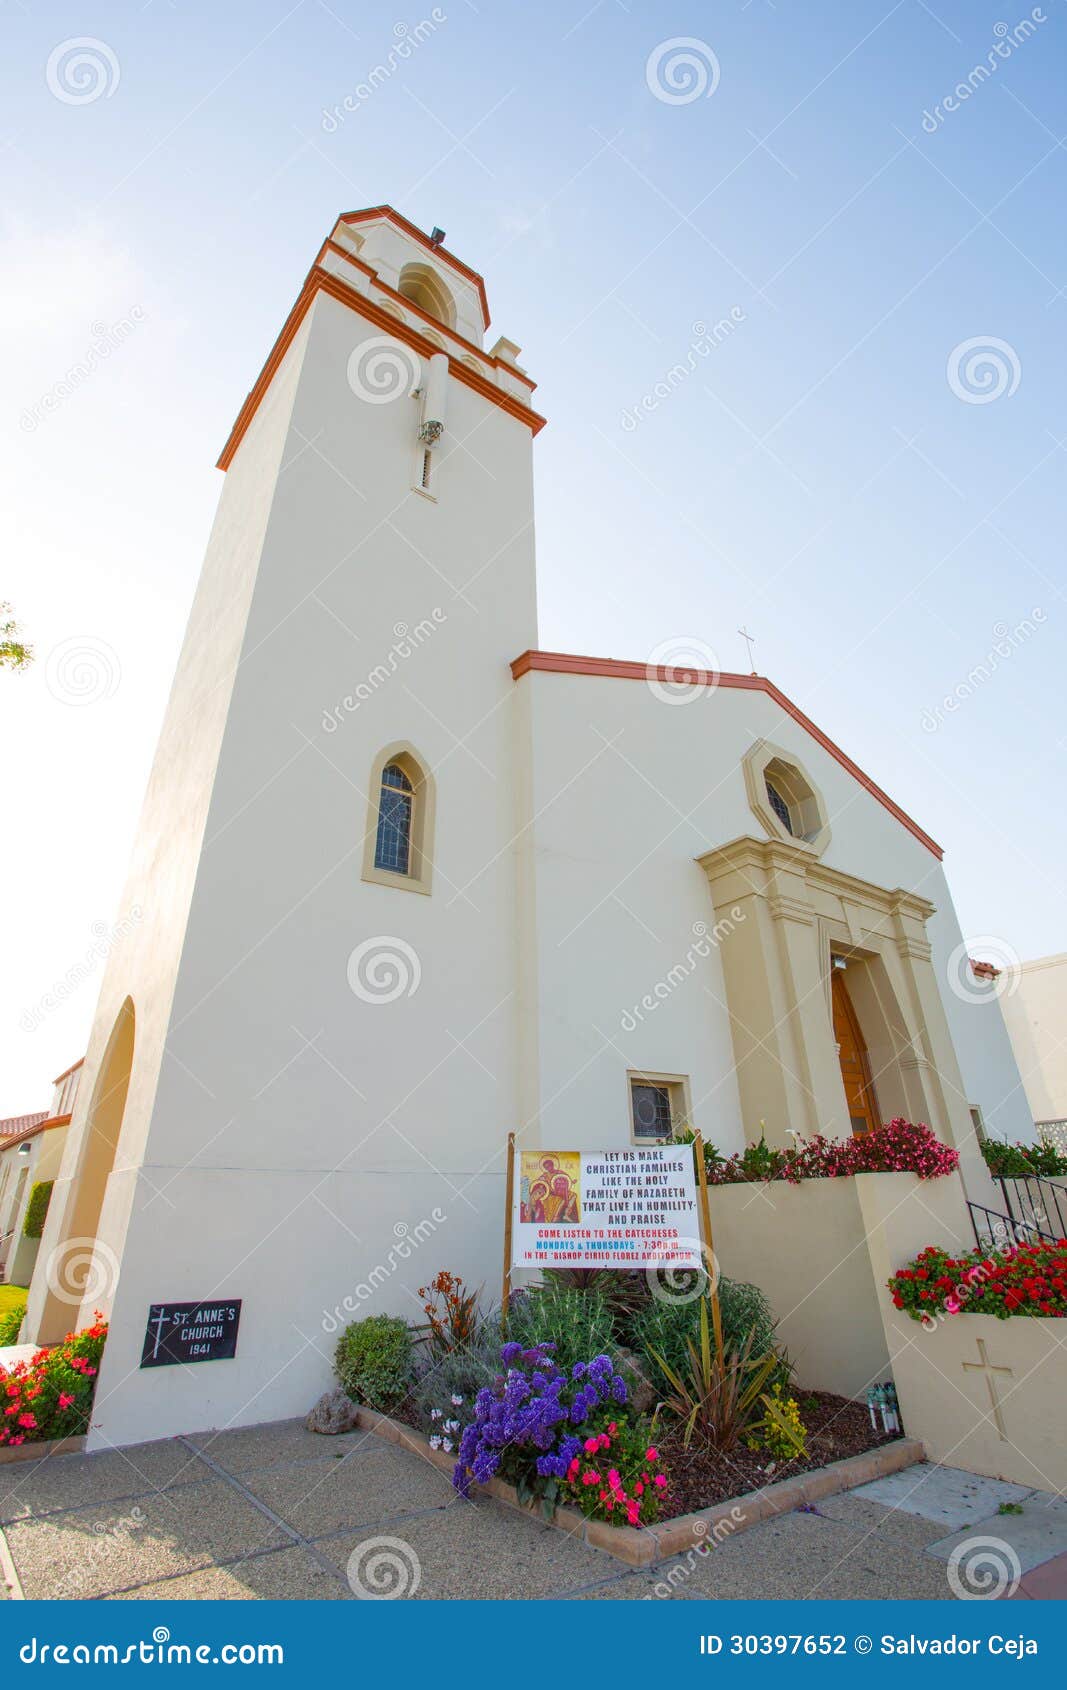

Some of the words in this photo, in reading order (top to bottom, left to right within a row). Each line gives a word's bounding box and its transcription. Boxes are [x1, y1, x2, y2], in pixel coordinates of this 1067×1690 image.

[605, 1152, 619, 1161] LET
[623, 1152, 635, 1160] US
[638, 1151, 664, 1160] MAKE
[586, 1164, 637, 1174] CHRISTIAN
[640, 1162, 684, 1173] FAMILIES
[602, 1177, 622, 1186] LIKE
[625, 1176, 642, 1185] THE
[645, 1175, 668, 1185] HOLY
[586, 1189, 618, 1199] FAMILY
[622, 1189, 634, 1199] OF
[637, 1187, 685, 1198] NAZARETH
[583, 1202, 606, 1212] THAT
[609, 1202, 630, 1211] LIVE
[633, 1201, 643, 1211] IN
[608, 1215, 627, 1225] AND
[631, 1214, 666, 1225] PRAISE
[538, 1229, 561, 1239] COME
[563, 1229, 591, 1239] LISTEN
[594, 1229, 604, 1239] TO
[607, 1229, 622, 1239] THE
[625, 1228, 678, 1238] CATECHESES
[536, 1241, 574, 1250] MONDAYS
[586, 1240, 635, 1250] THURSDAYS
[535, 1251, 548, 1260] THE
[585, 1251, 610, 1260] CIRILO
[613, 1251, 639, 1260] FLOREZ
[172, 1312, 190, 1325] ST.
[194, 1308, 236, 1323] ANNE'S
[181, 1326, 224, 1340] CHURCH
[190, 1343, 211, 1355] 1941
